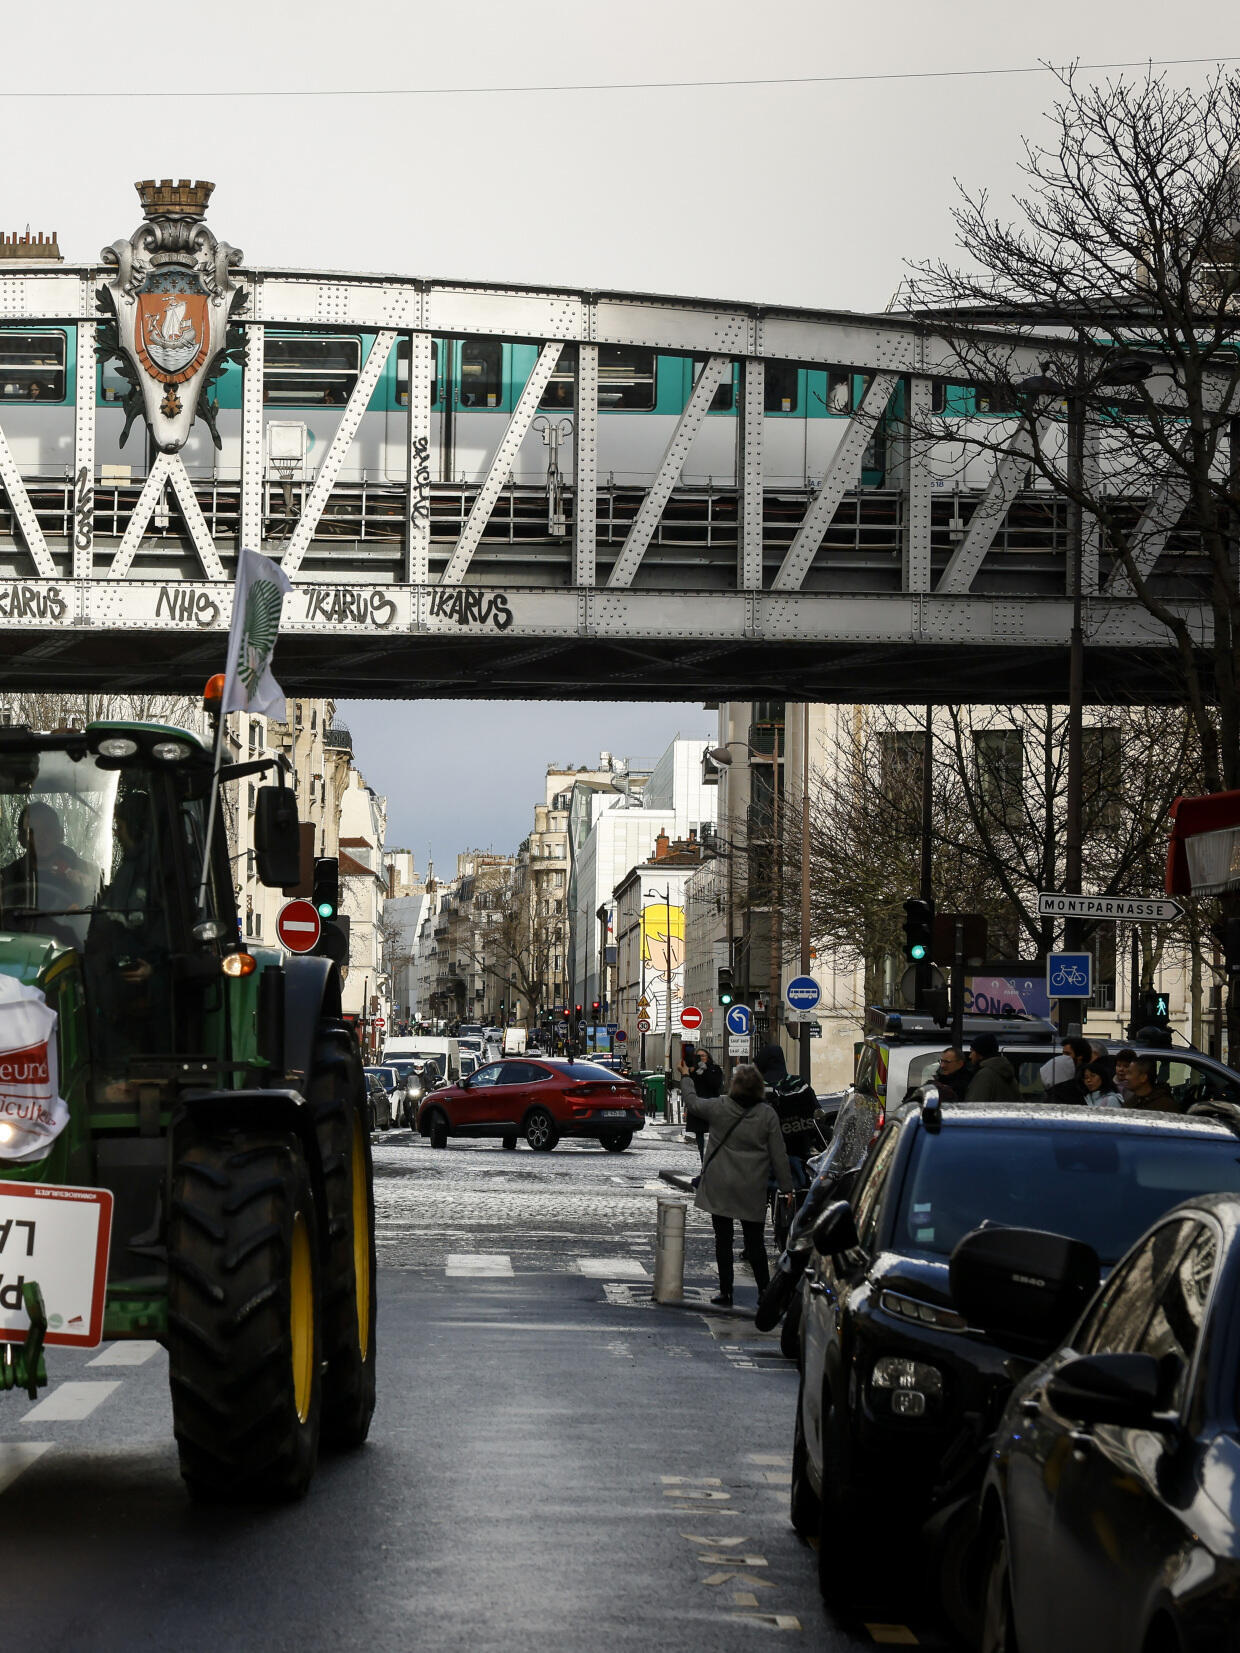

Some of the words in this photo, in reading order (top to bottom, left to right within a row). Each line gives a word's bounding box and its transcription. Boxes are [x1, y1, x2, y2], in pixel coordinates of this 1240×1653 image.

[302, 588, 398, 629] IKARUS
[426, 588, 513, 632] IKARUS
[1044, 899, 1164, 917] MONTPARNASSE
[639, 1022, 648, 1030] 30
